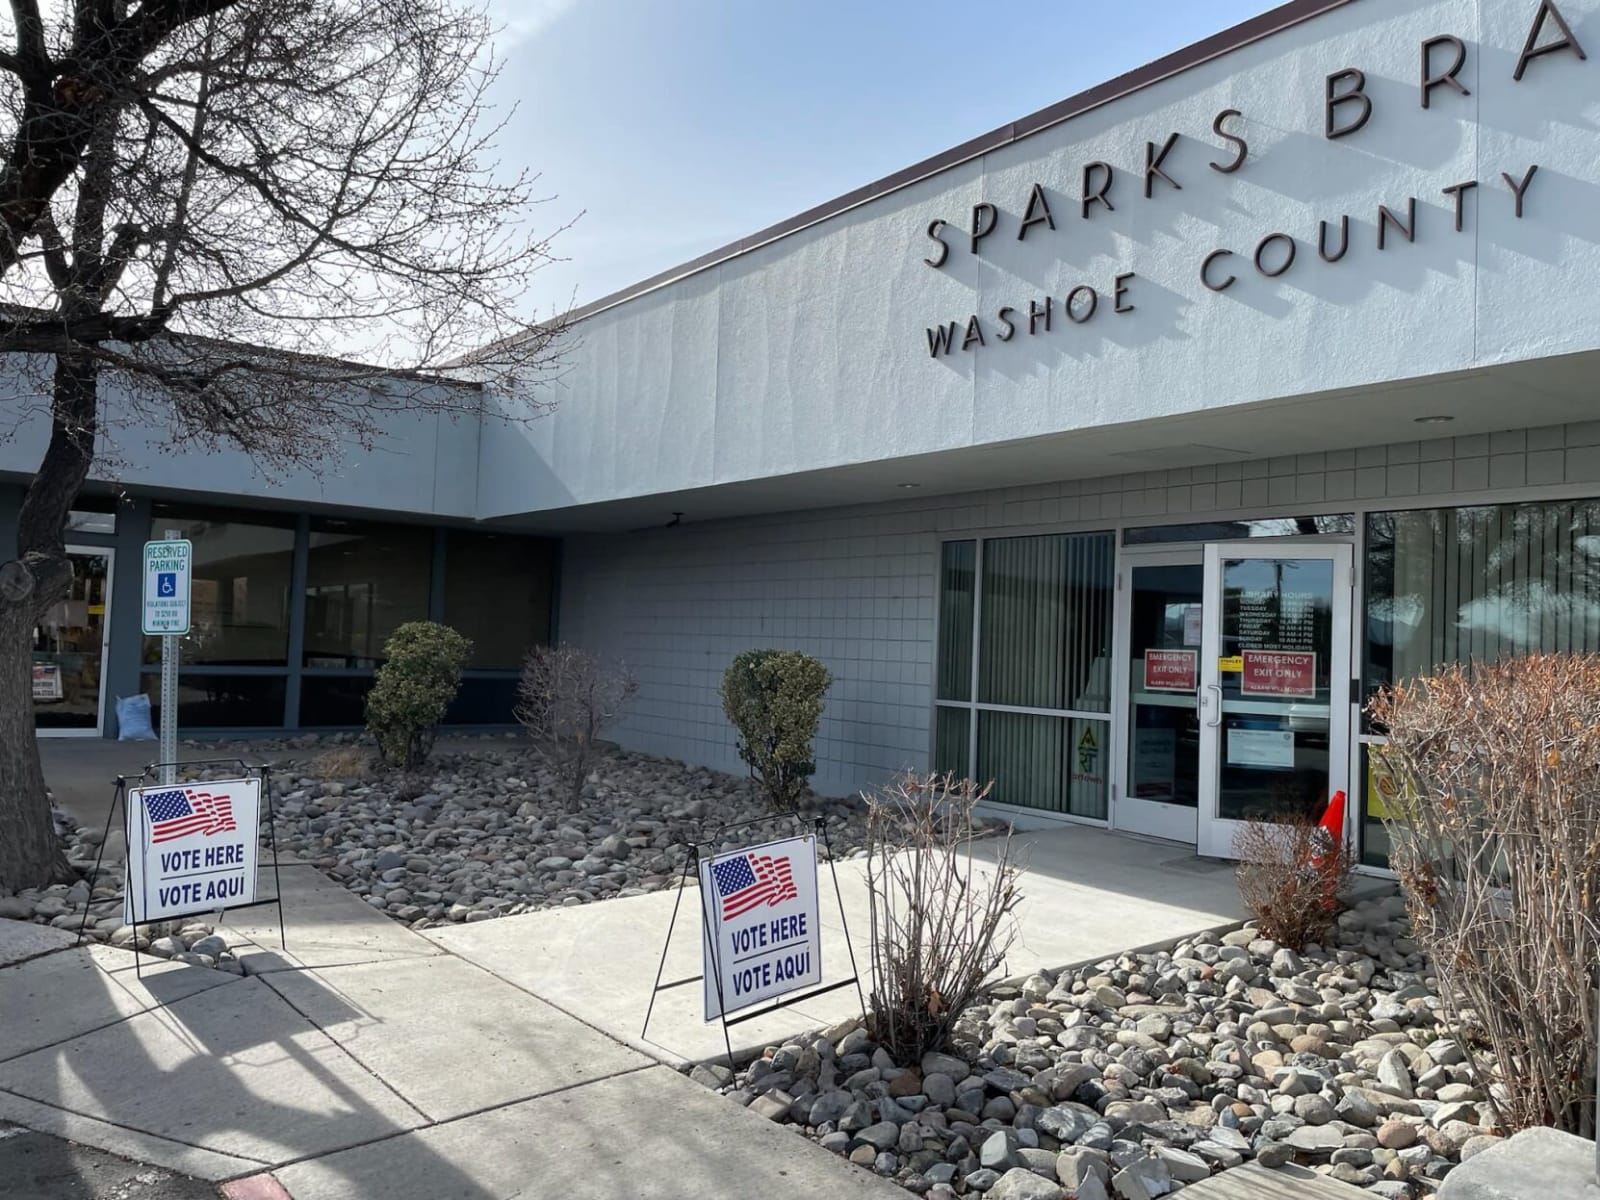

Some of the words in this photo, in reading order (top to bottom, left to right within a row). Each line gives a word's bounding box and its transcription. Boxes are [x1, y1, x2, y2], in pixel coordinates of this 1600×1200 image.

[924, 109, 1249, 268] SPARKS
[1324, 0, 1587, 139] BRA
[925, 271, 1135, 358] WASHOE
[1199, 164, 1539, 291] COUNTY
[147, 545, 187, 559] RESERVED
[150, 559, 185, 571] PARKING
[1149, 653, 1193, 661] EMERGENCY
[1248, 654, 1309, 665] EMERGENCY
[1153, 665, 1167, 673] EXIT
[1168, 665, 1188, 674] ONLY
[1254, 668, 1273, 677] EXIT
[1275, 669, 1303, 679] ONLY
[161, 849, 200, 873] VOTE
[205, 843, 244, 867] HERE
[159, 882, 202, 907] VOTE
[731, 923, 767, 955] VOTE
[771, 912, 807, 944] HERE
[732, 962, 771, 996] VOTE
